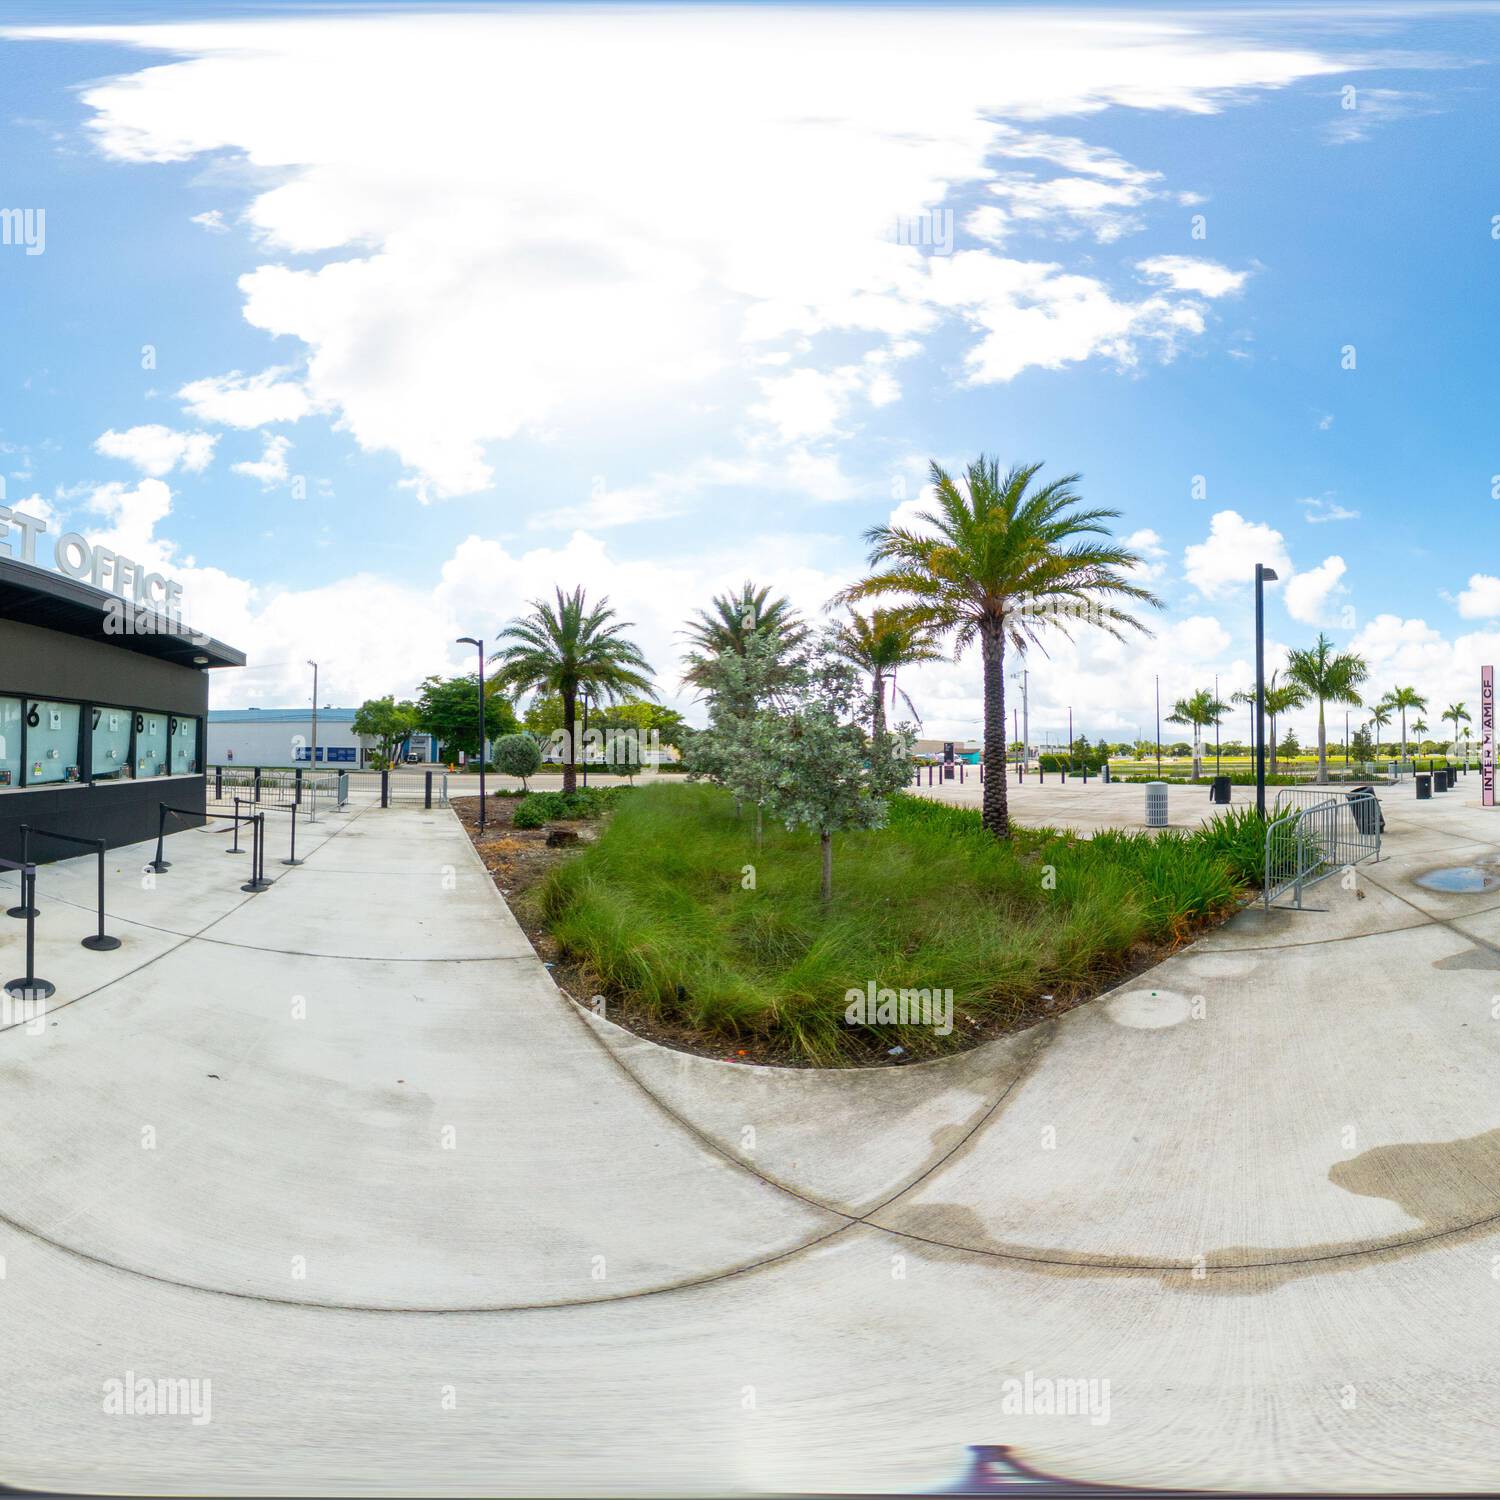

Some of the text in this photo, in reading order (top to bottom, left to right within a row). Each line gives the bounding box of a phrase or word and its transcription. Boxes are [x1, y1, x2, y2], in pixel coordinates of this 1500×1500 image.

[55, 532, 183, 612] OFFICE
[1484, 680, 1491, 699] CF
[27, 704, 40, 727] 6
[92, 709, 102, 730] 7
[136, 714, 144, 733] 8
[171, 719, 177, 736] 9
